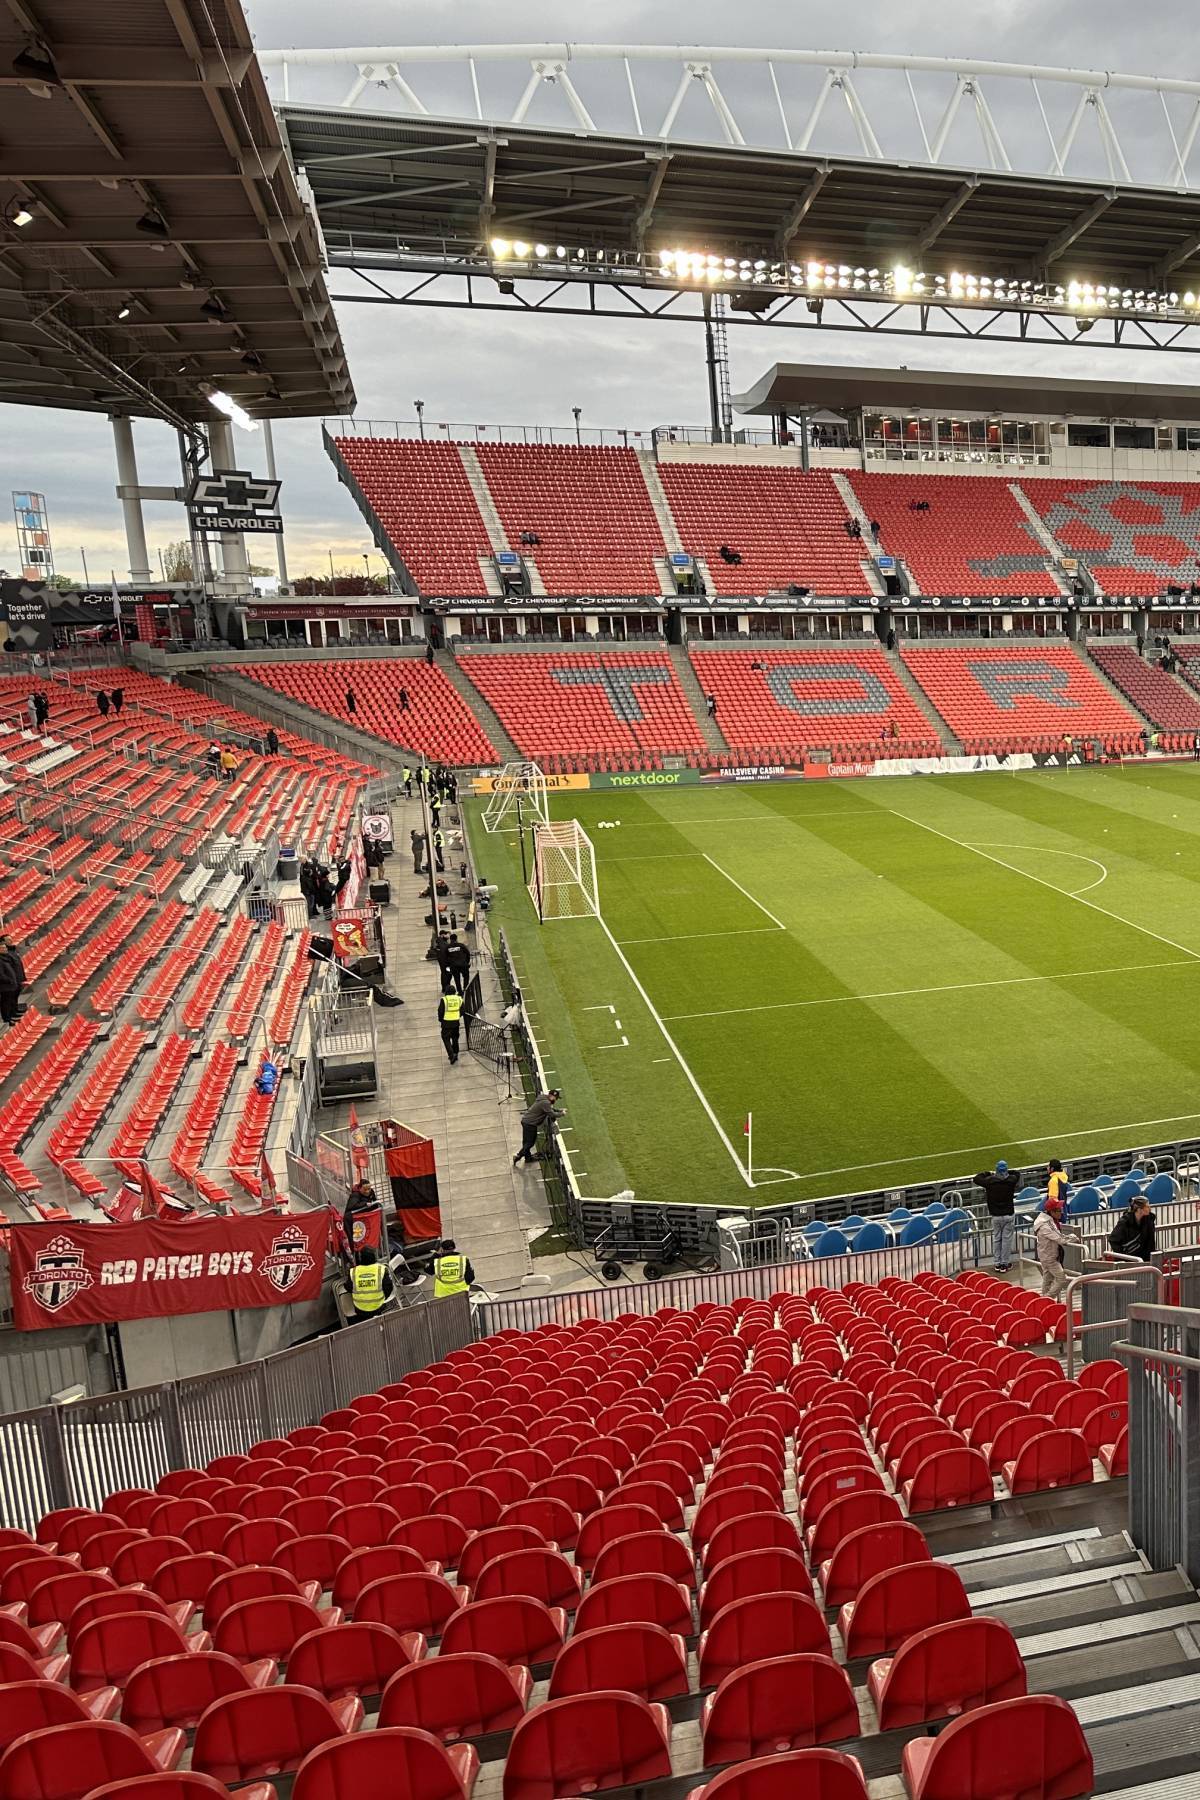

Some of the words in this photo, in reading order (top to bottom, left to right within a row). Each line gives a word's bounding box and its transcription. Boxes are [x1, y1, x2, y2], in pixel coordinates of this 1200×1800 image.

[195, 516, 281, 530] CHEVROLET
[526, 597, 568, 605] CHEVROLET
[597, 597, 638, 605] CHEVROLET
[7, 604, 41, 612] Together
[9, 612, 25, 620] let's
[27, 612, 45, 620] drive
[720, 767, 758, 776] FALLSVIEW
[759, 766, 785, 775] CASINO
[610, 773, 681, 786] nextdoor
[268, 1255, 306, 1265] TORONTO
[101, 1260, 136, 1285] RED
[142, 1254, 203, 1282] PATCH
[208, 1251, 254, 1276] BOYS
[29, 1268, 86, 1282] TORONTO
[358, 1279, 376, 1287] SECURITY
